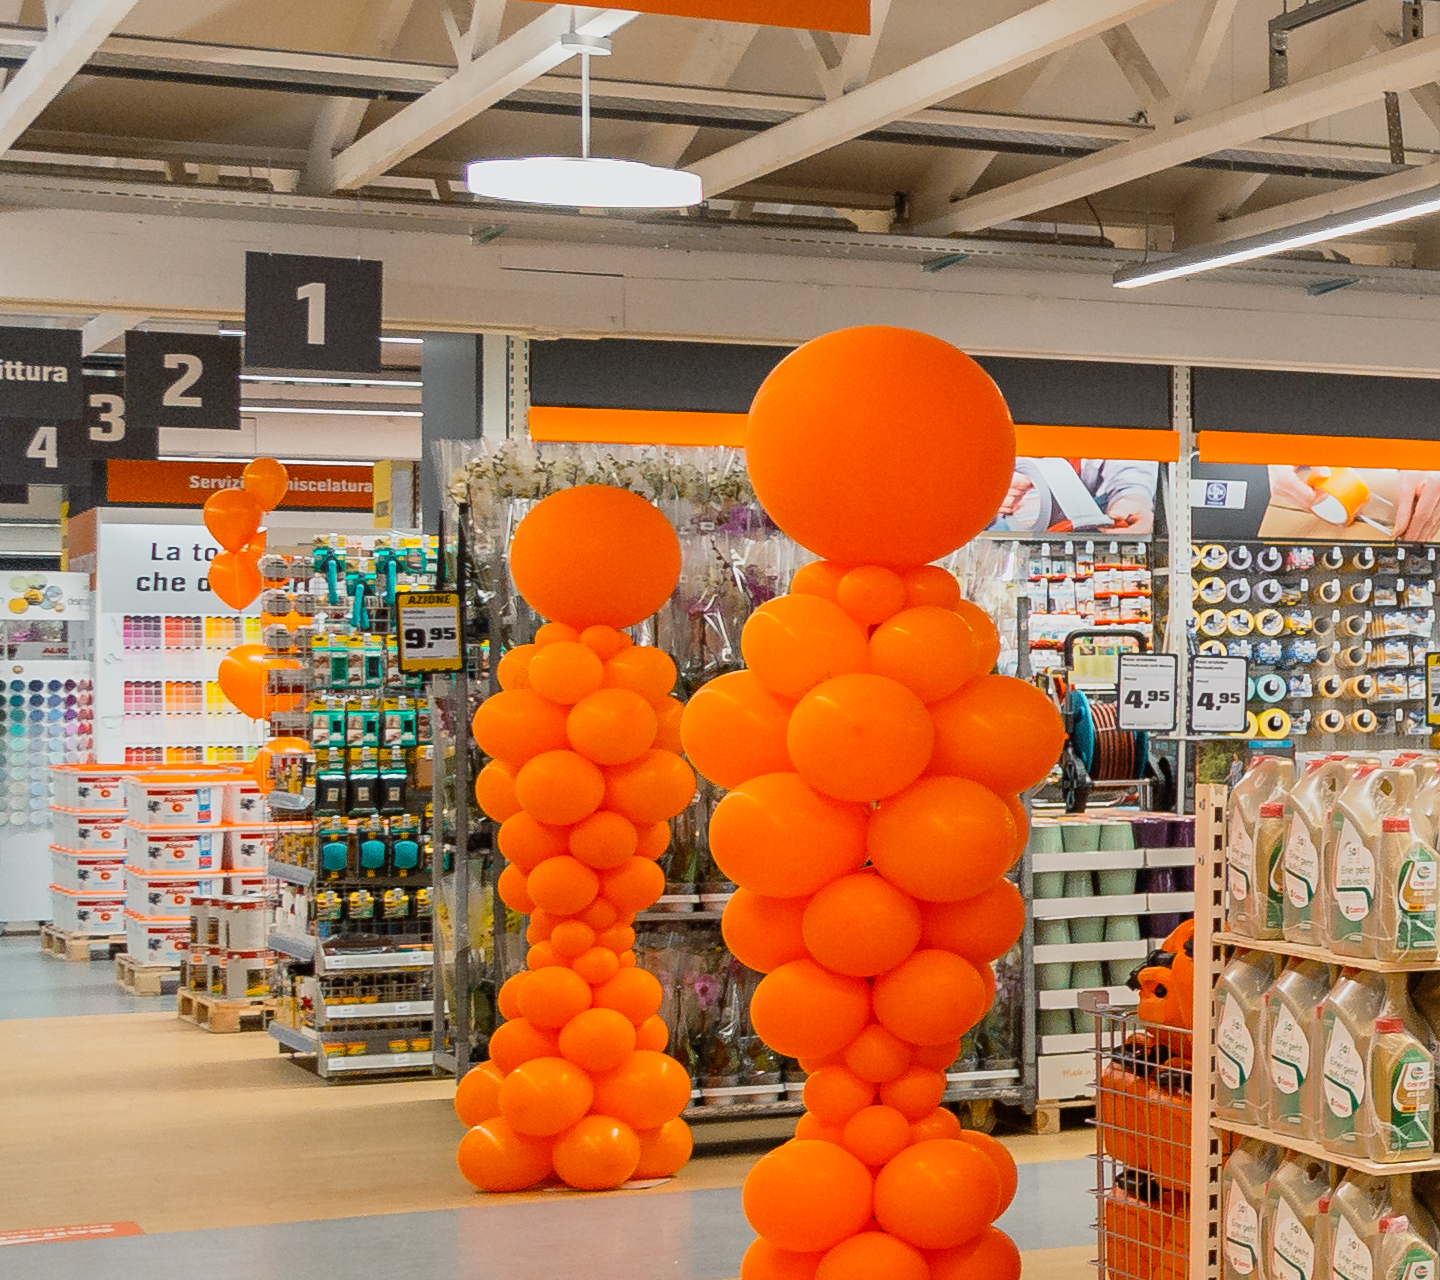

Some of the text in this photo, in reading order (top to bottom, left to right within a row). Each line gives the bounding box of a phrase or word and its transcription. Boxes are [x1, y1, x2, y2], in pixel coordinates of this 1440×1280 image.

[297, 282, 326, 345] 1
[163, 353, 203, 407] 2
[89, 394, 126, 442] 3
[25, 426, 58, 468] 4
[152, 543, 179, 561] La
[137, 572, 185, 591] che
[408, 595, 451, 604] AZIONE
